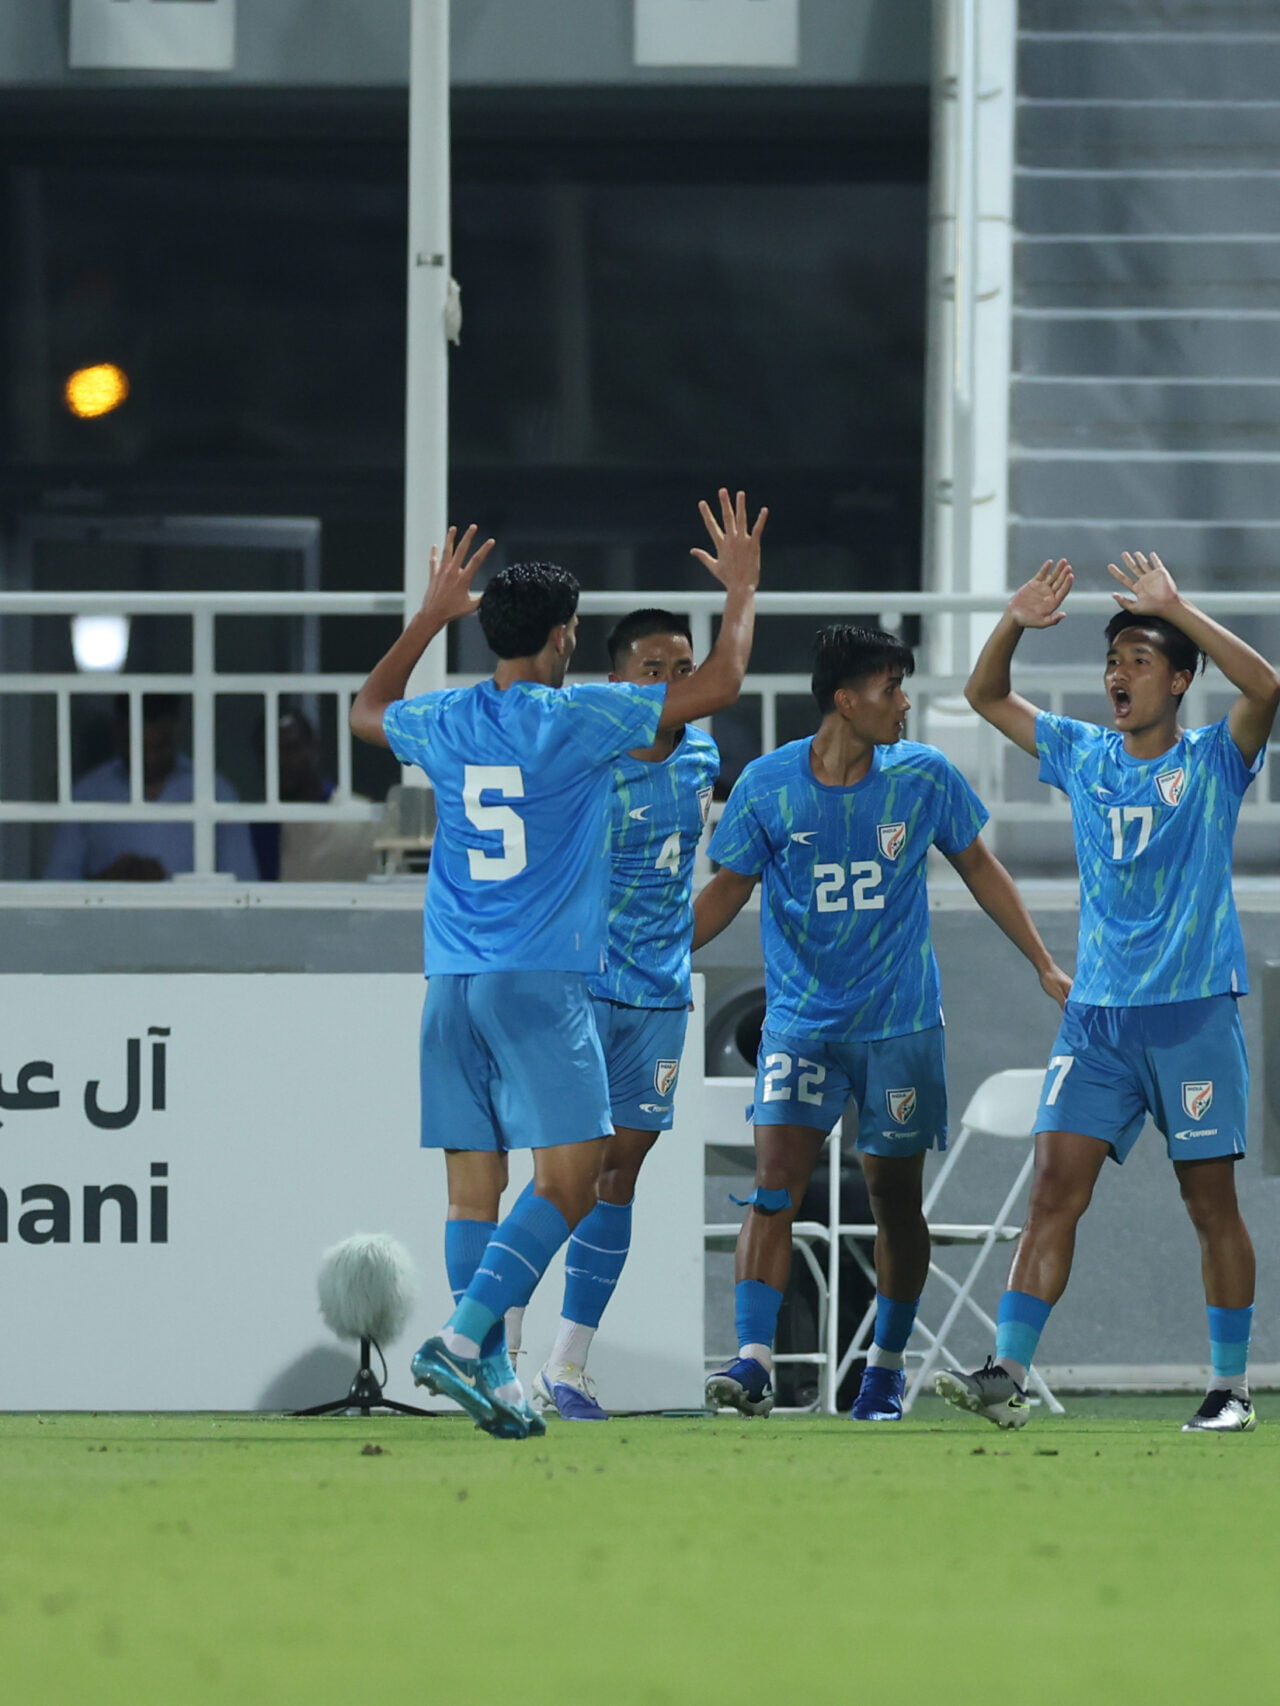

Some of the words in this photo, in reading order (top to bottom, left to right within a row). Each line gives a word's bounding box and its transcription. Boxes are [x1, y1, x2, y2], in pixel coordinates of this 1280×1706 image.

[462, 764, 527, 881] 5
[1107, 806, 1153, 860] 17
[655, 831, 682, 877] 4
[814, 861, 885, 913] 22
[84, 1026, 171, 1130] آل
[762, 1053, 826, 1106] 22
[1046, 1055, 1075, 1106] 7
[0, 1162, 168, 1244] ani
